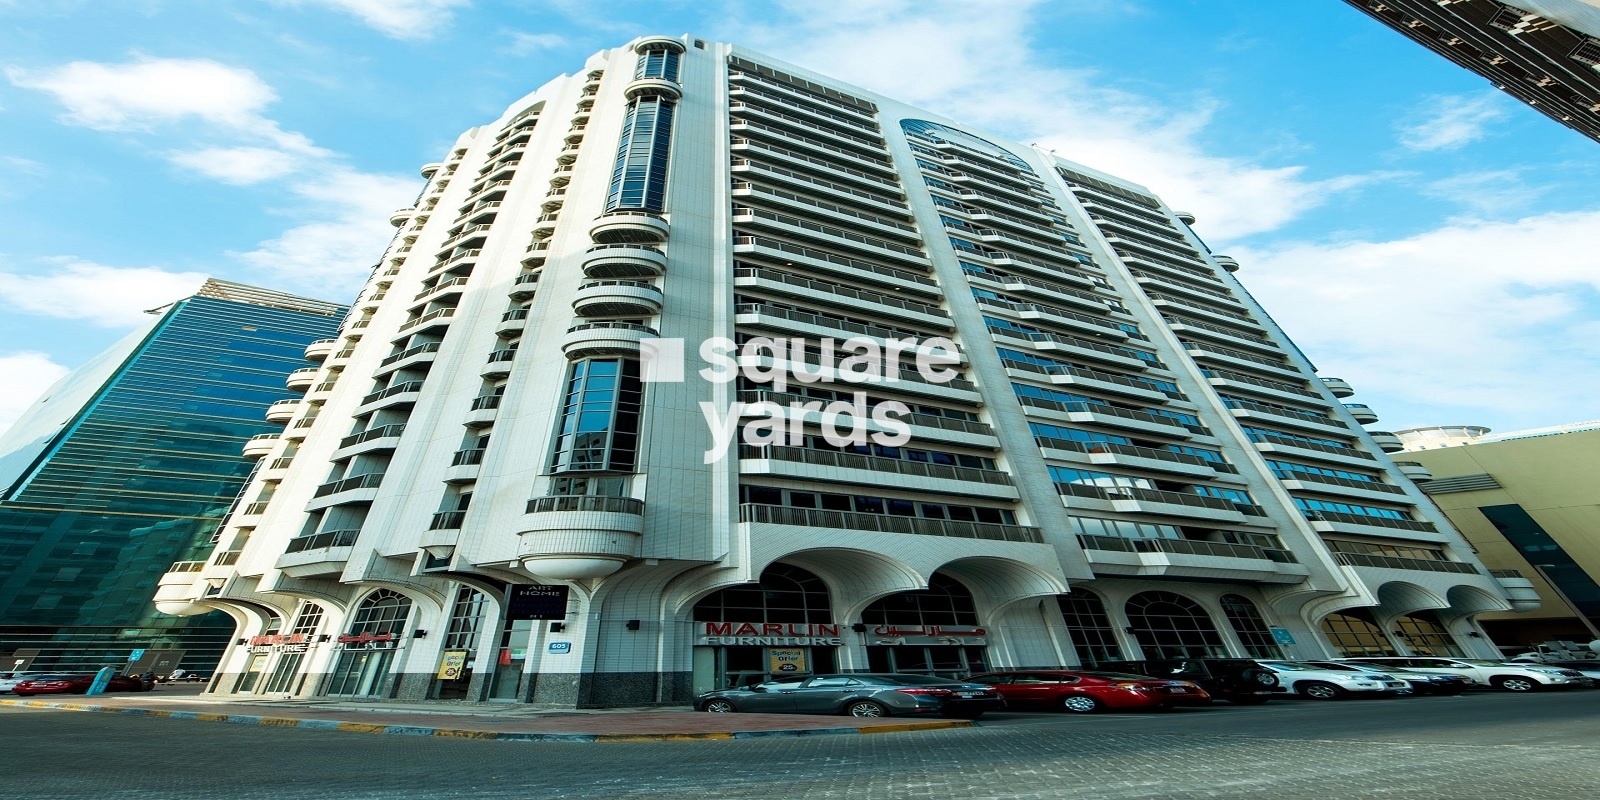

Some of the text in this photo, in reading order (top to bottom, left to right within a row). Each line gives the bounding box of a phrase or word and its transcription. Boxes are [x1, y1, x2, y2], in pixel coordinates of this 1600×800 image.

[706, 622, 839, 636] MARLIN
[250, 633, 304, 645] MARLIN
[701, 636, 842, 646] FURNITURE
